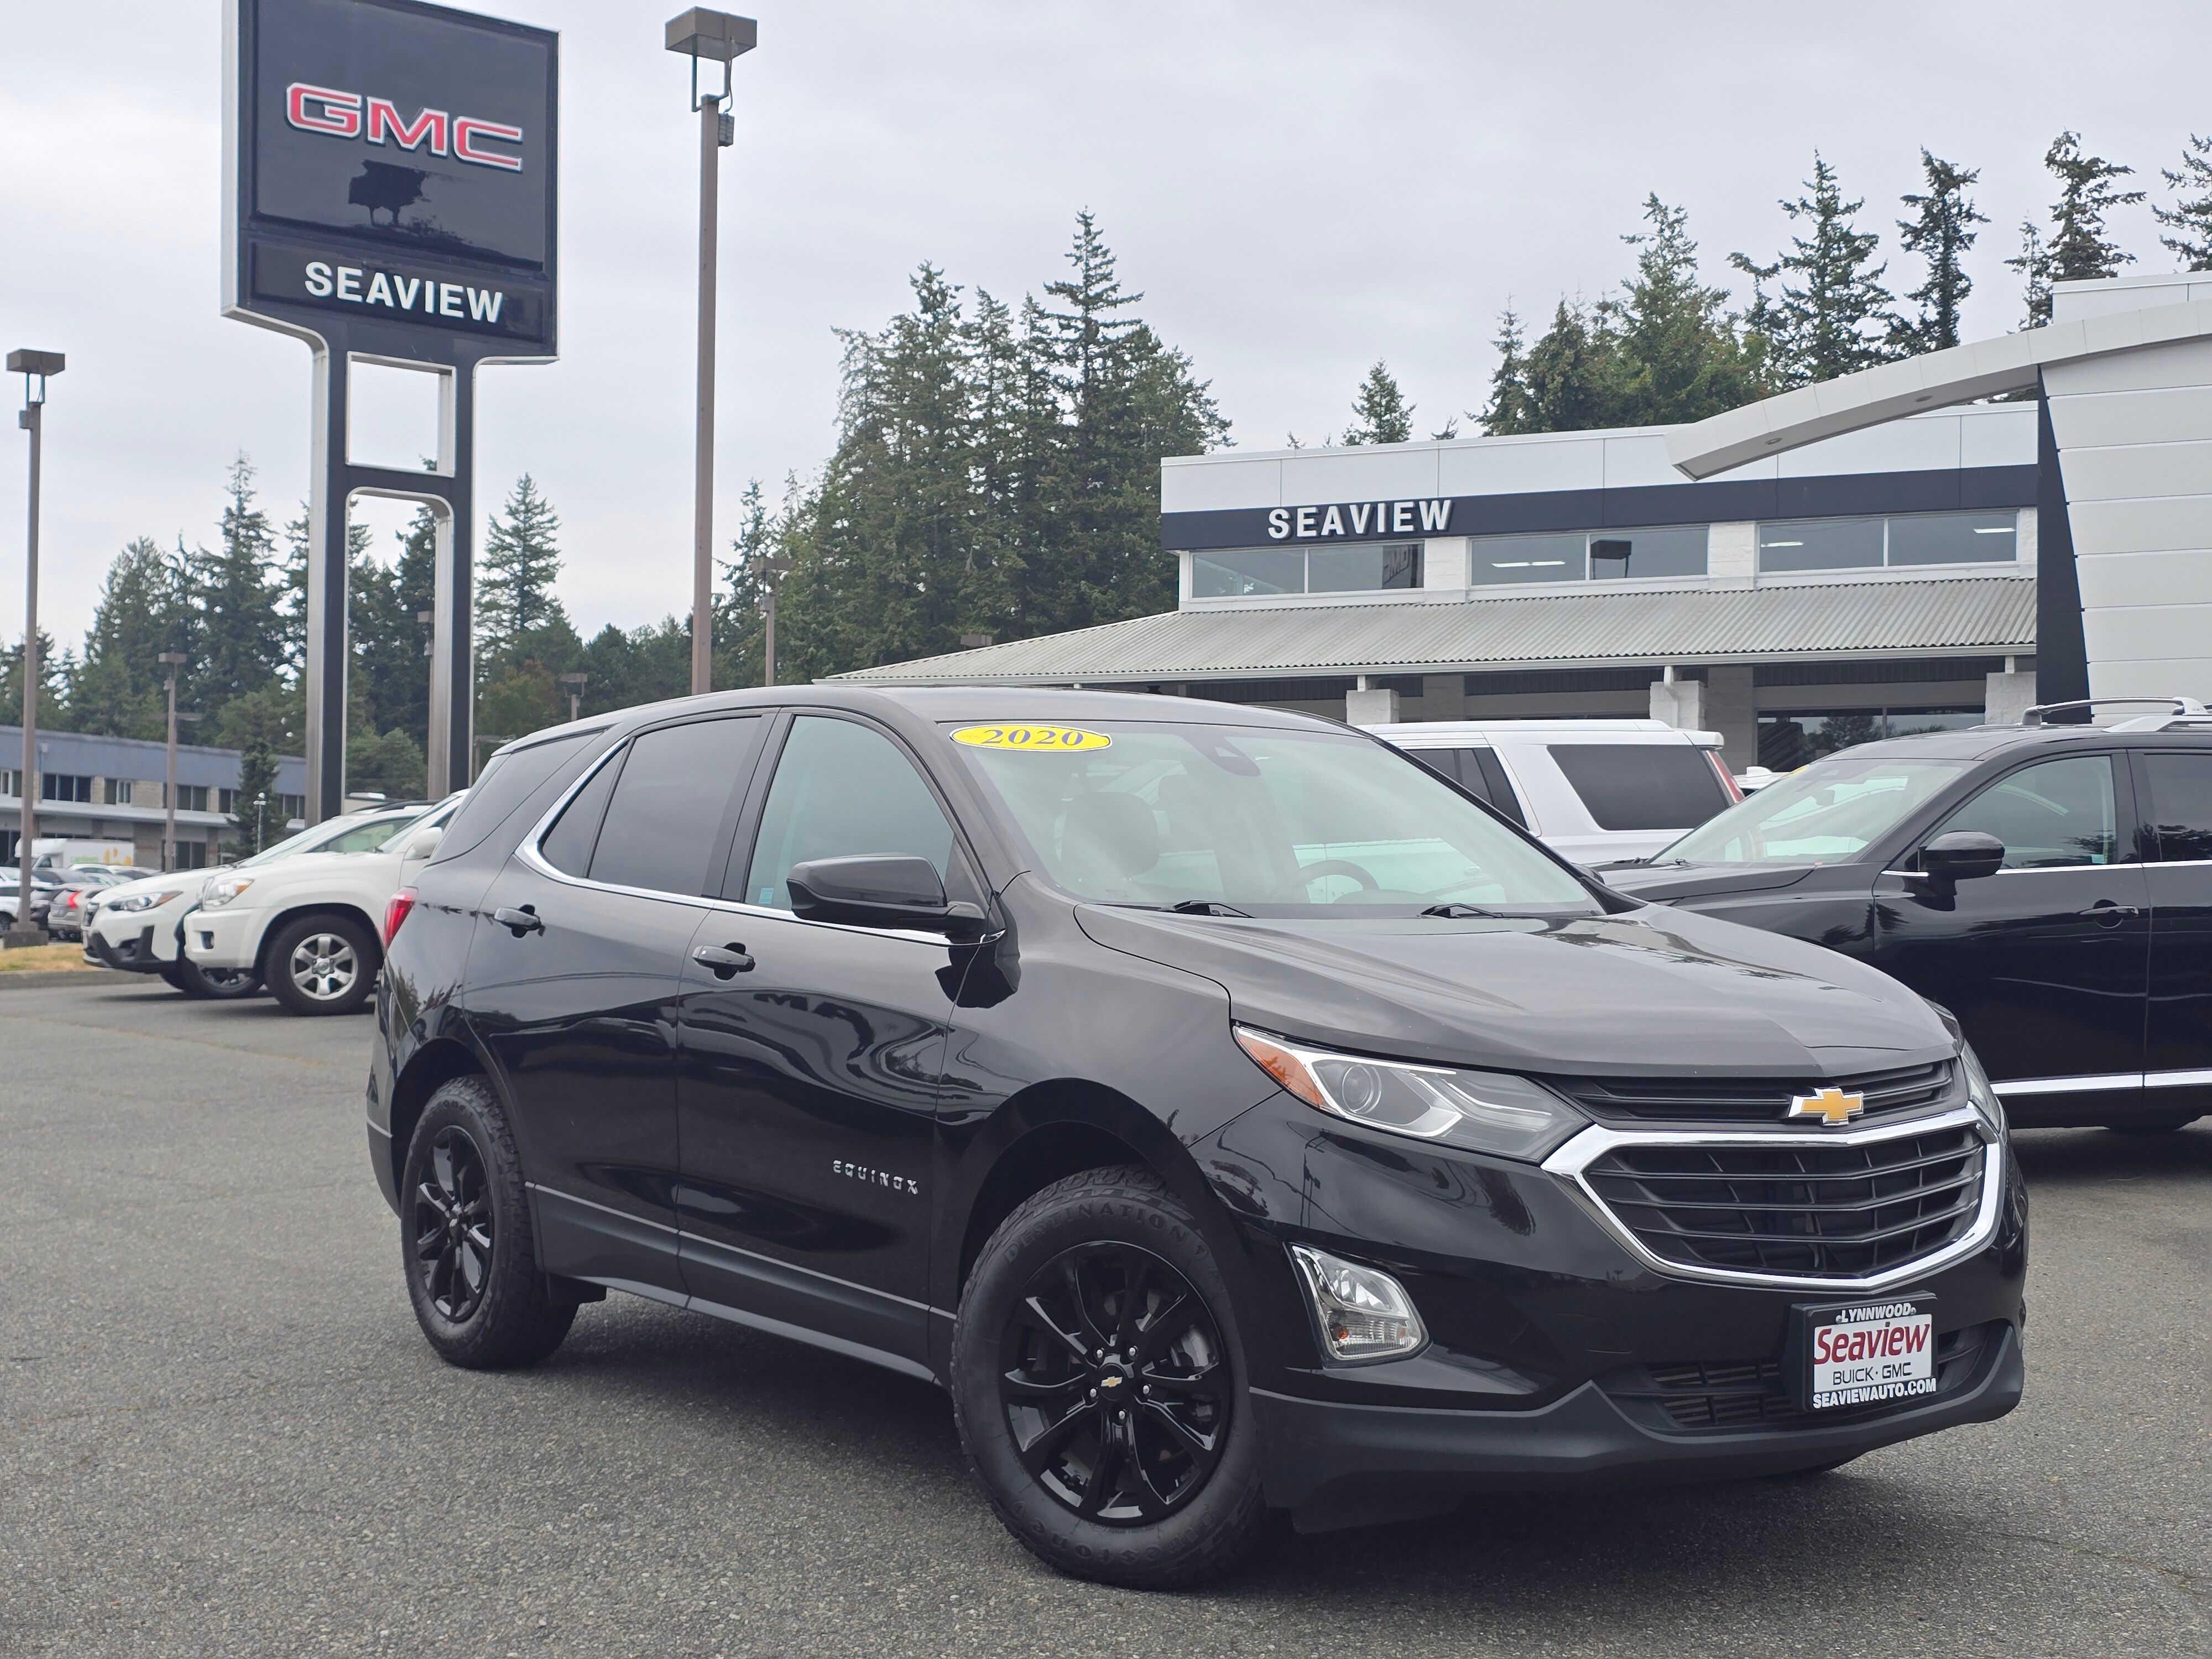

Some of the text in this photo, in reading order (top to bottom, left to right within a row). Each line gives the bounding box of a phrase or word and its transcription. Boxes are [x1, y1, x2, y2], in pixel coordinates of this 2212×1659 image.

[286, 82, 523, 171] GMC
[305, 262, 503, 323] SEAVIEW
[1268, 499, 1452, 539] SEAVIEW
[980, 729, 1084, 745] 2020
[833, 1160, 919, 1194] EQUINOX
[1840, 1302, 1912, 1323] LYNNWOOD
[1814, 1321, 1931, 1365] Seaview
[1833, 1362, 1913, 1385] BUICK GMC
[1812, 1378, 1937, 1409] SEAVIEWAUTO.COM
